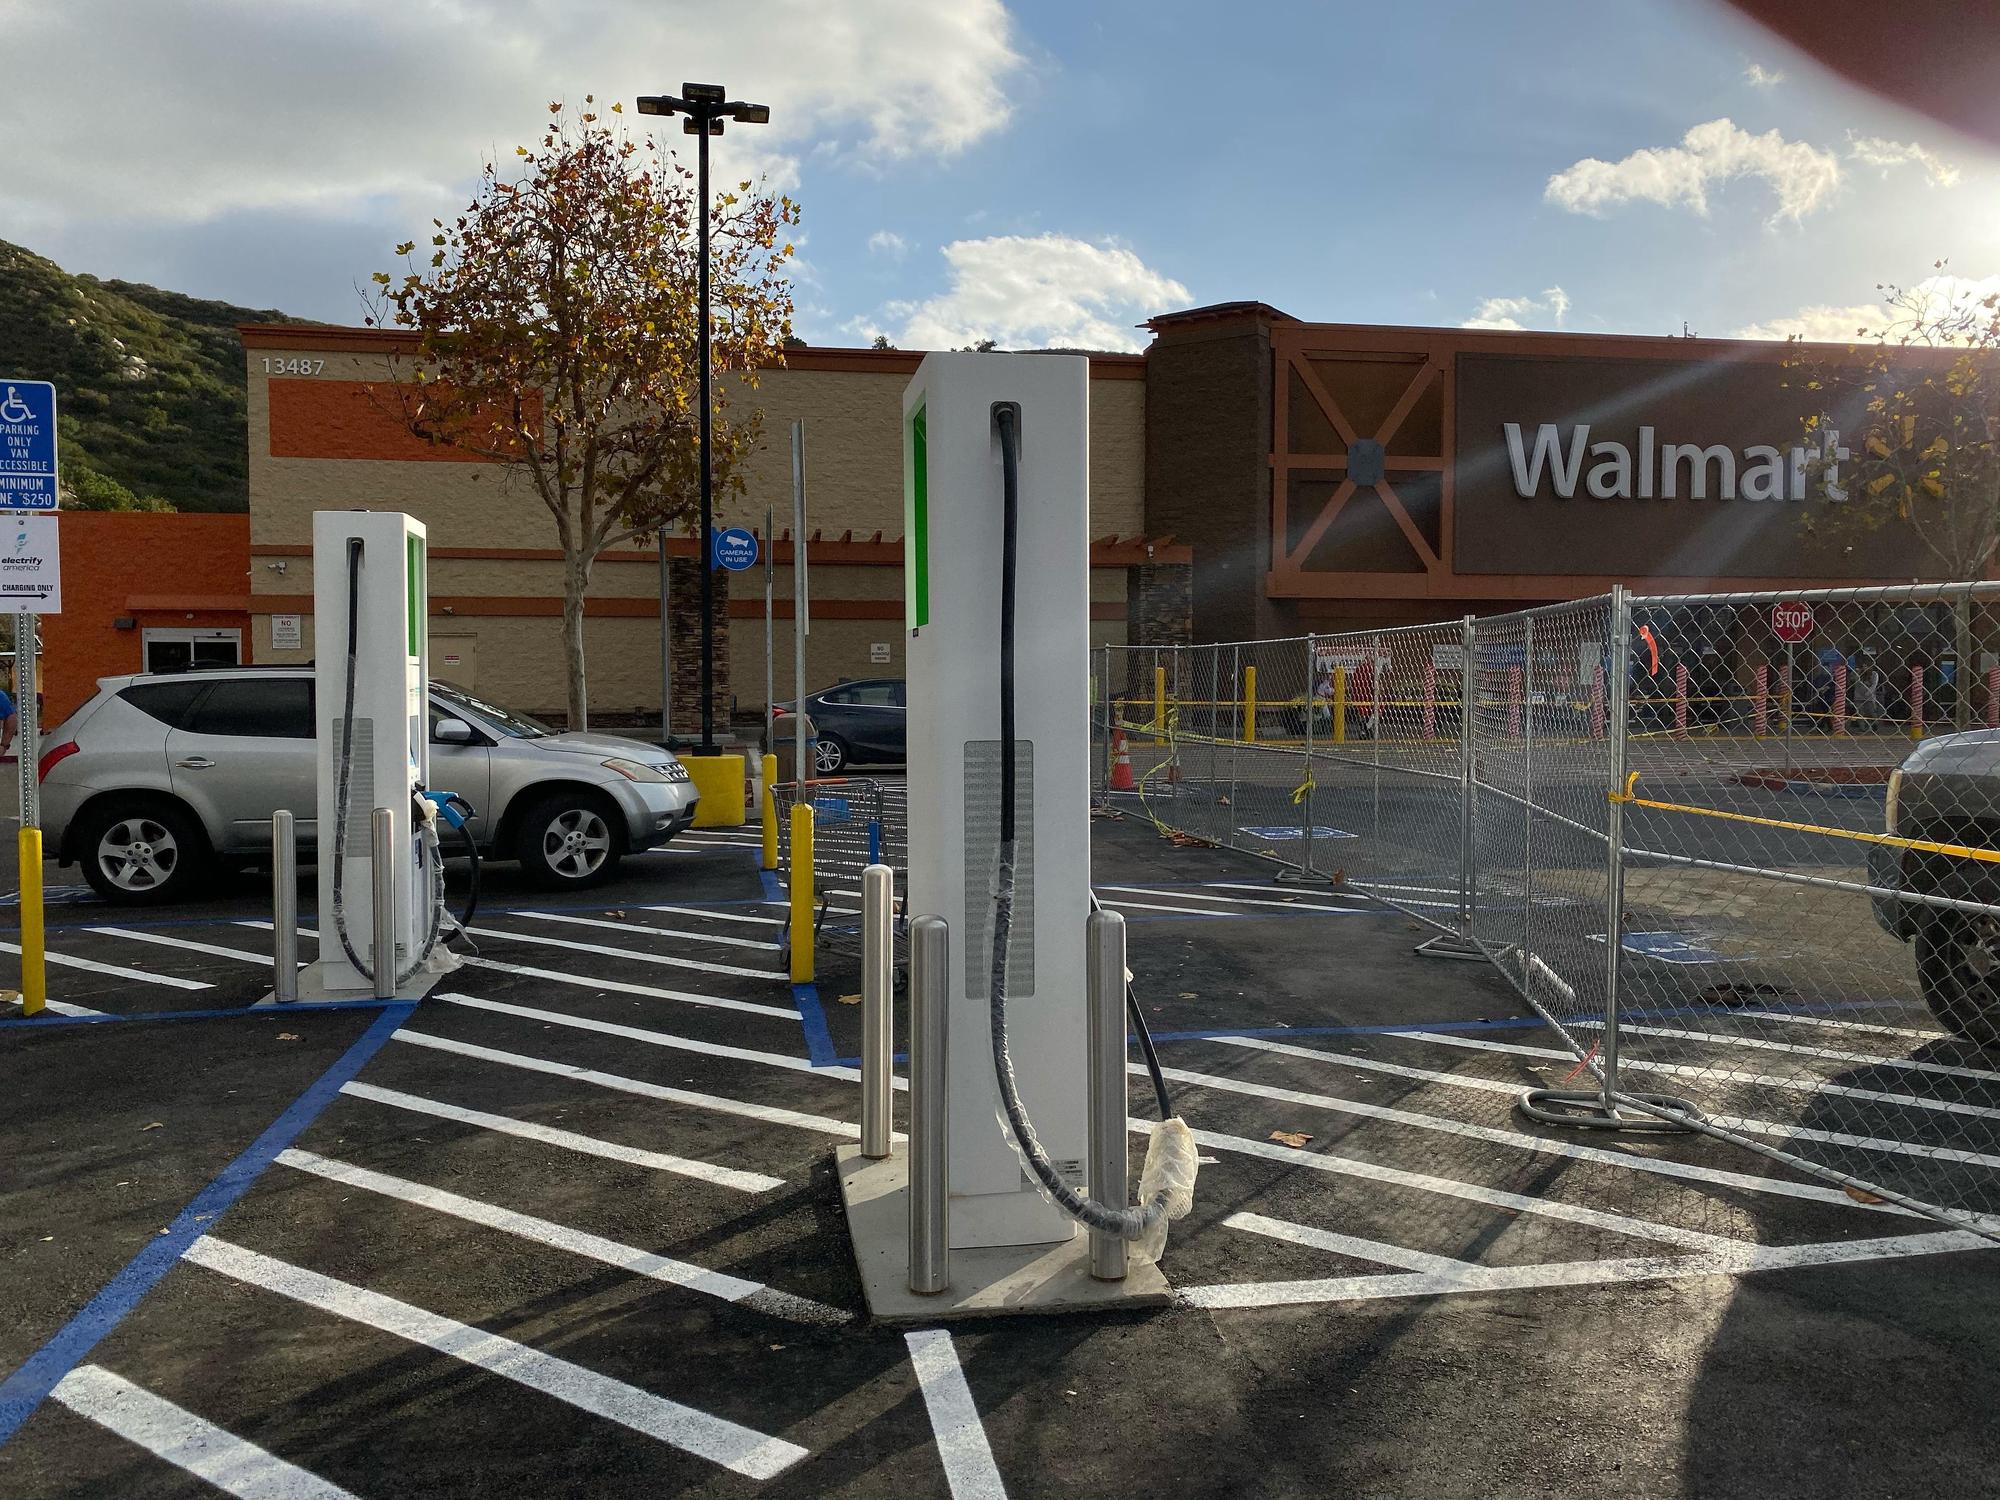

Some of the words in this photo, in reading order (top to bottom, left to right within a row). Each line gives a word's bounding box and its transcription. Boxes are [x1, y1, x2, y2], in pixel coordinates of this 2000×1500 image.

[262, 358, 325, 375] 13487
[0, 424, 39, 436] PARKING
[7, 436, 32, 447] ONLY
[10, 448, 29, 459] VAN
[0, 460, 48, 471] CCESSIBLE
[1503, 422, 1850, 501] Walmart
[0, 478, 44, 490] MINIMUM
[0, 492, 13, 505] NE
[22, 492, 52, 506] $250
[1, 557, 43, 566] electrify
[3, 564, 40, 572] america
[2, 584, 36, 592] CHARGING
[37, 584, 54, 592] ONLY
[1776, 611, 1810, 628] STOP
